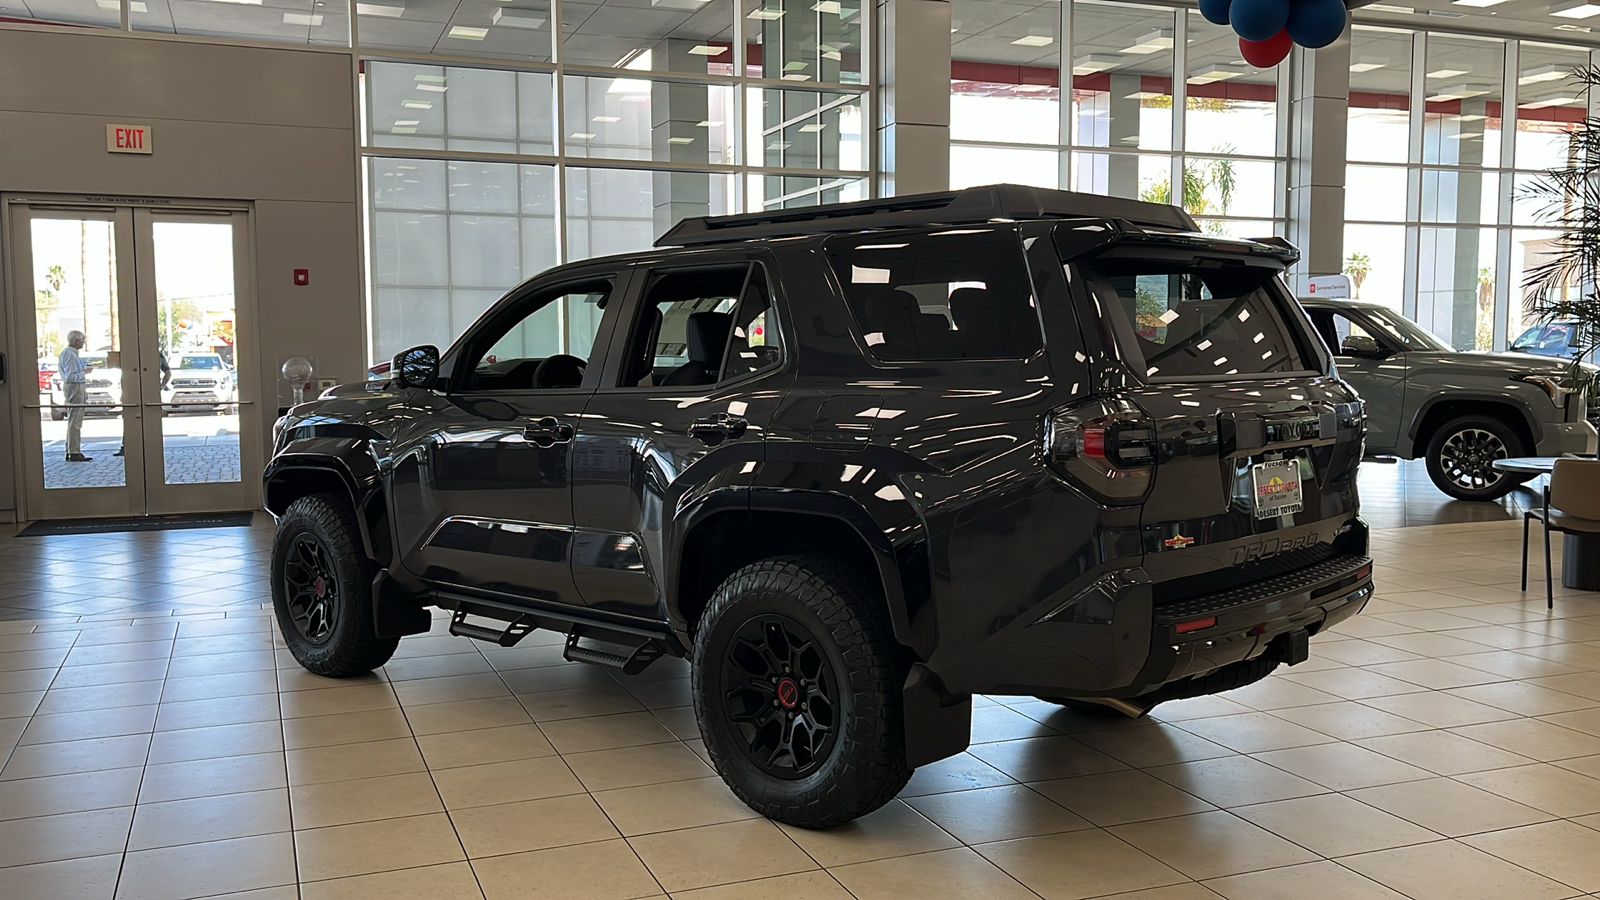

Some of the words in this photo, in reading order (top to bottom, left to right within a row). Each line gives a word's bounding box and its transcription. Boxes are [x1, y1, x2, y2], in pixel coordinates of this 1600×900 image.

[116, 128, 143, 149] EXIT
[1274, 421, 1315, 441] TOYOTA
[1257, 484, 1277, 496] DESERT
[1277, 481, 1298, 493] TOYOTA
[1259, 507, 1279, 518] DESERT
[1280, 504, 1302, 515] TOYOTA
[1229, 538, 1281, 568] TRD
